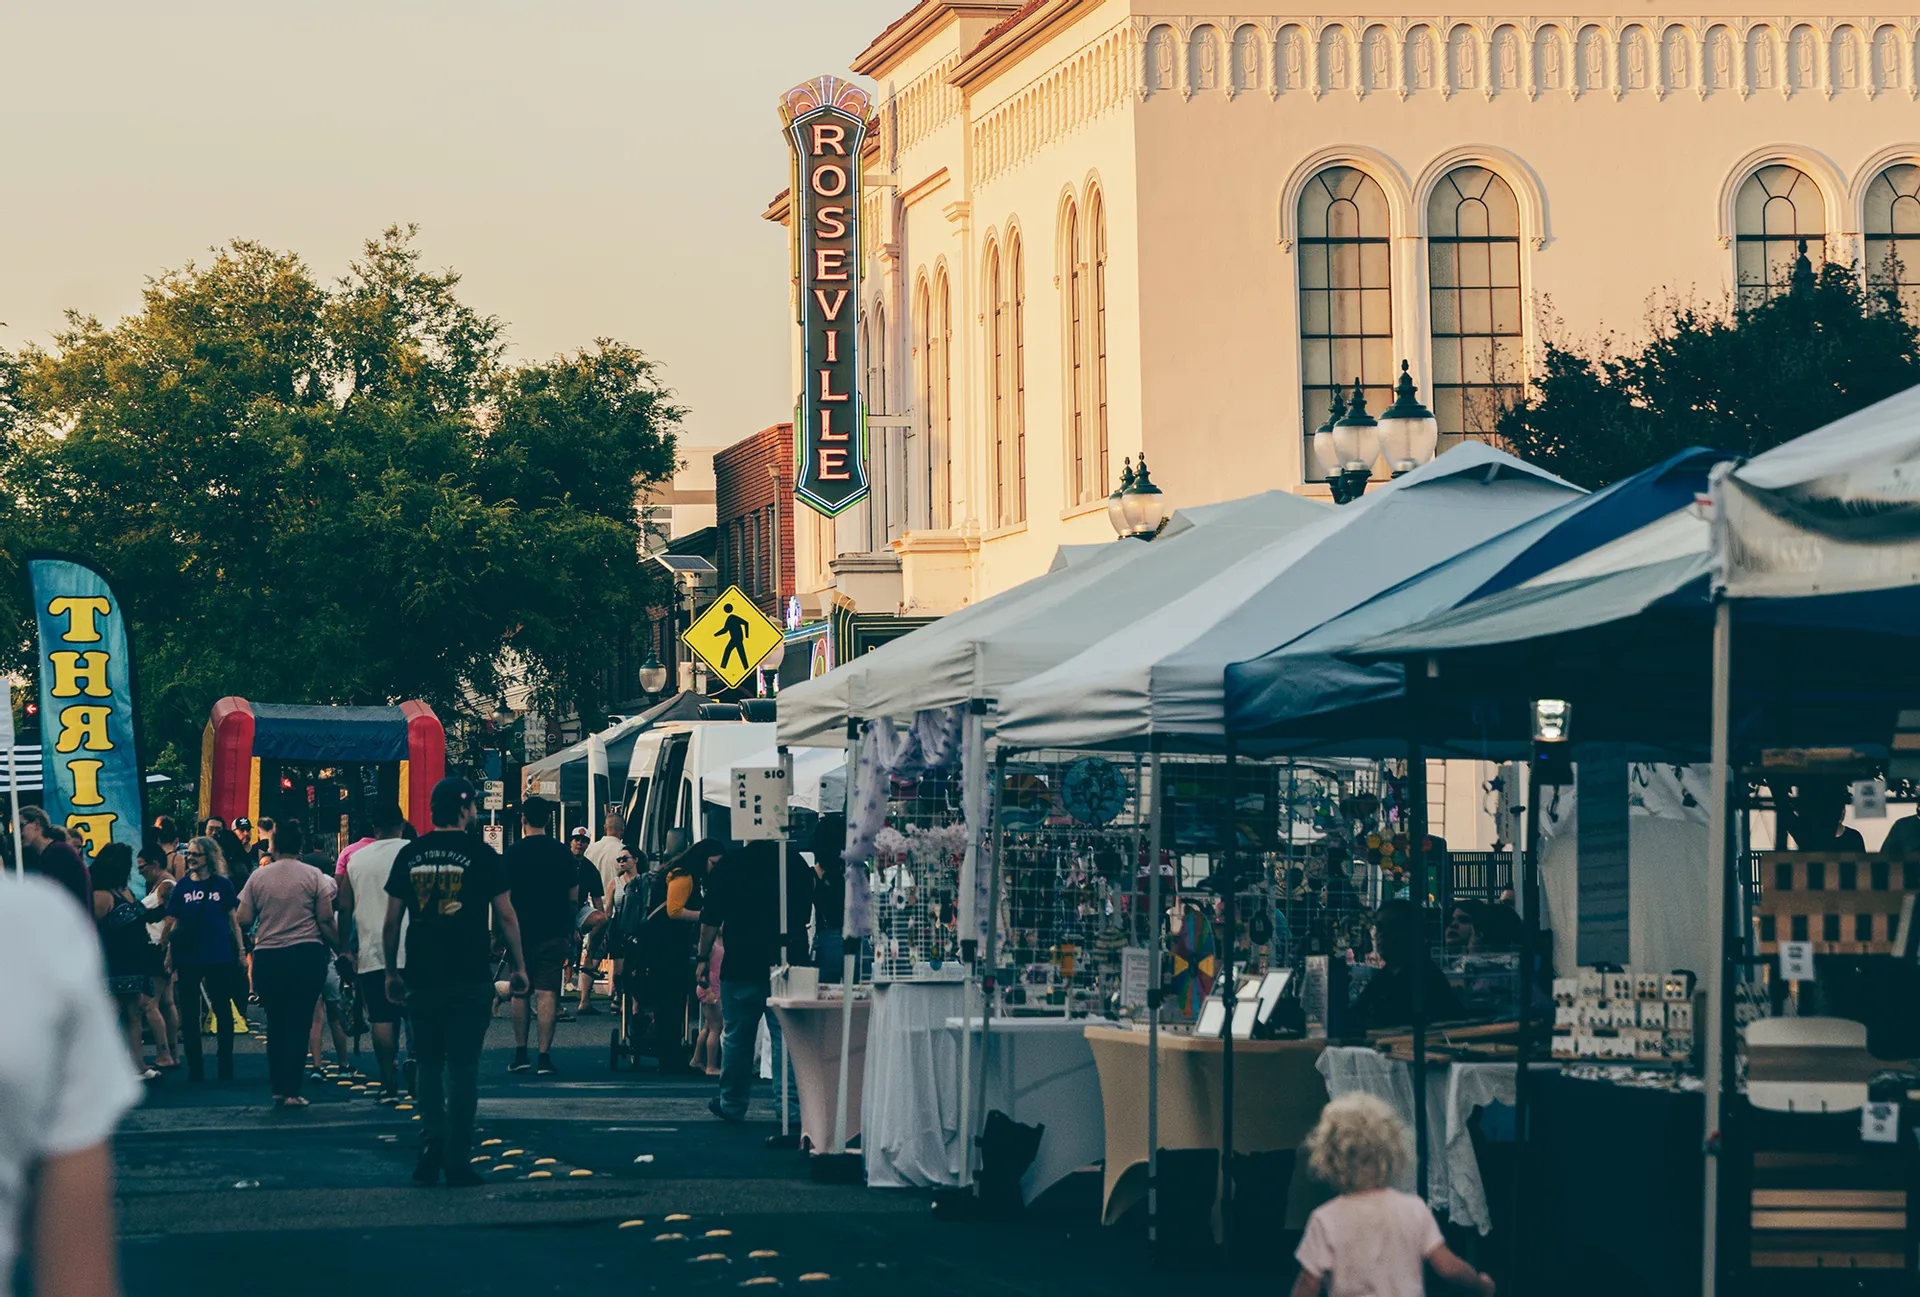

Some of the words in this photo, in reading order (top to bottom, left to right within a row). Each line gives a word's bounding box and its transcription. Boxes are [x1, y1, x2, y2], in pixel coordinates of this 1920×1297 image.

[810, 123, 850, 480] ROSEVILLE
[737, 773, 747, 809] MAKE
[754, 794, 762, 826] PEN
[447, 851, 471, 867] PIZZA
